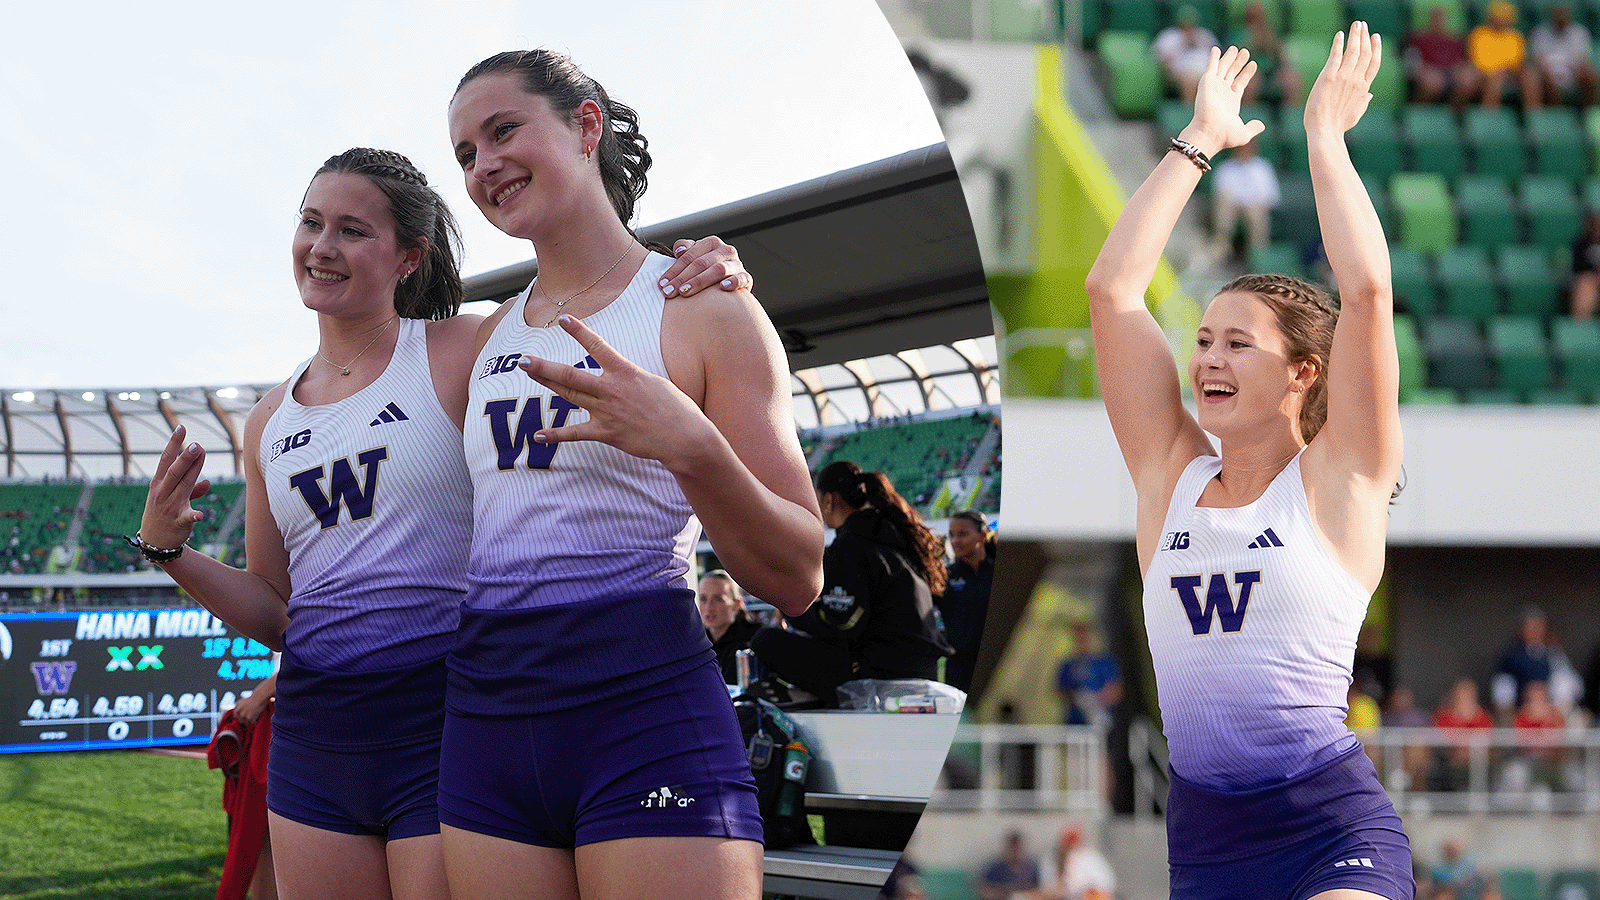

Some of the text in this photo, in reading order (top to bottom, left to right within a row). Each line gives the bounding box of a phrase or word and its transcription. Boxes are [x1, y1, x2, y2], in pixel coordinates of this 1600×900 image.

[483, 394, 583, 473] W
[288, 445, 389, 532] W
[75, 610, 228, 640] HANA MOLL
[1169, 568, 1263, 637] W
